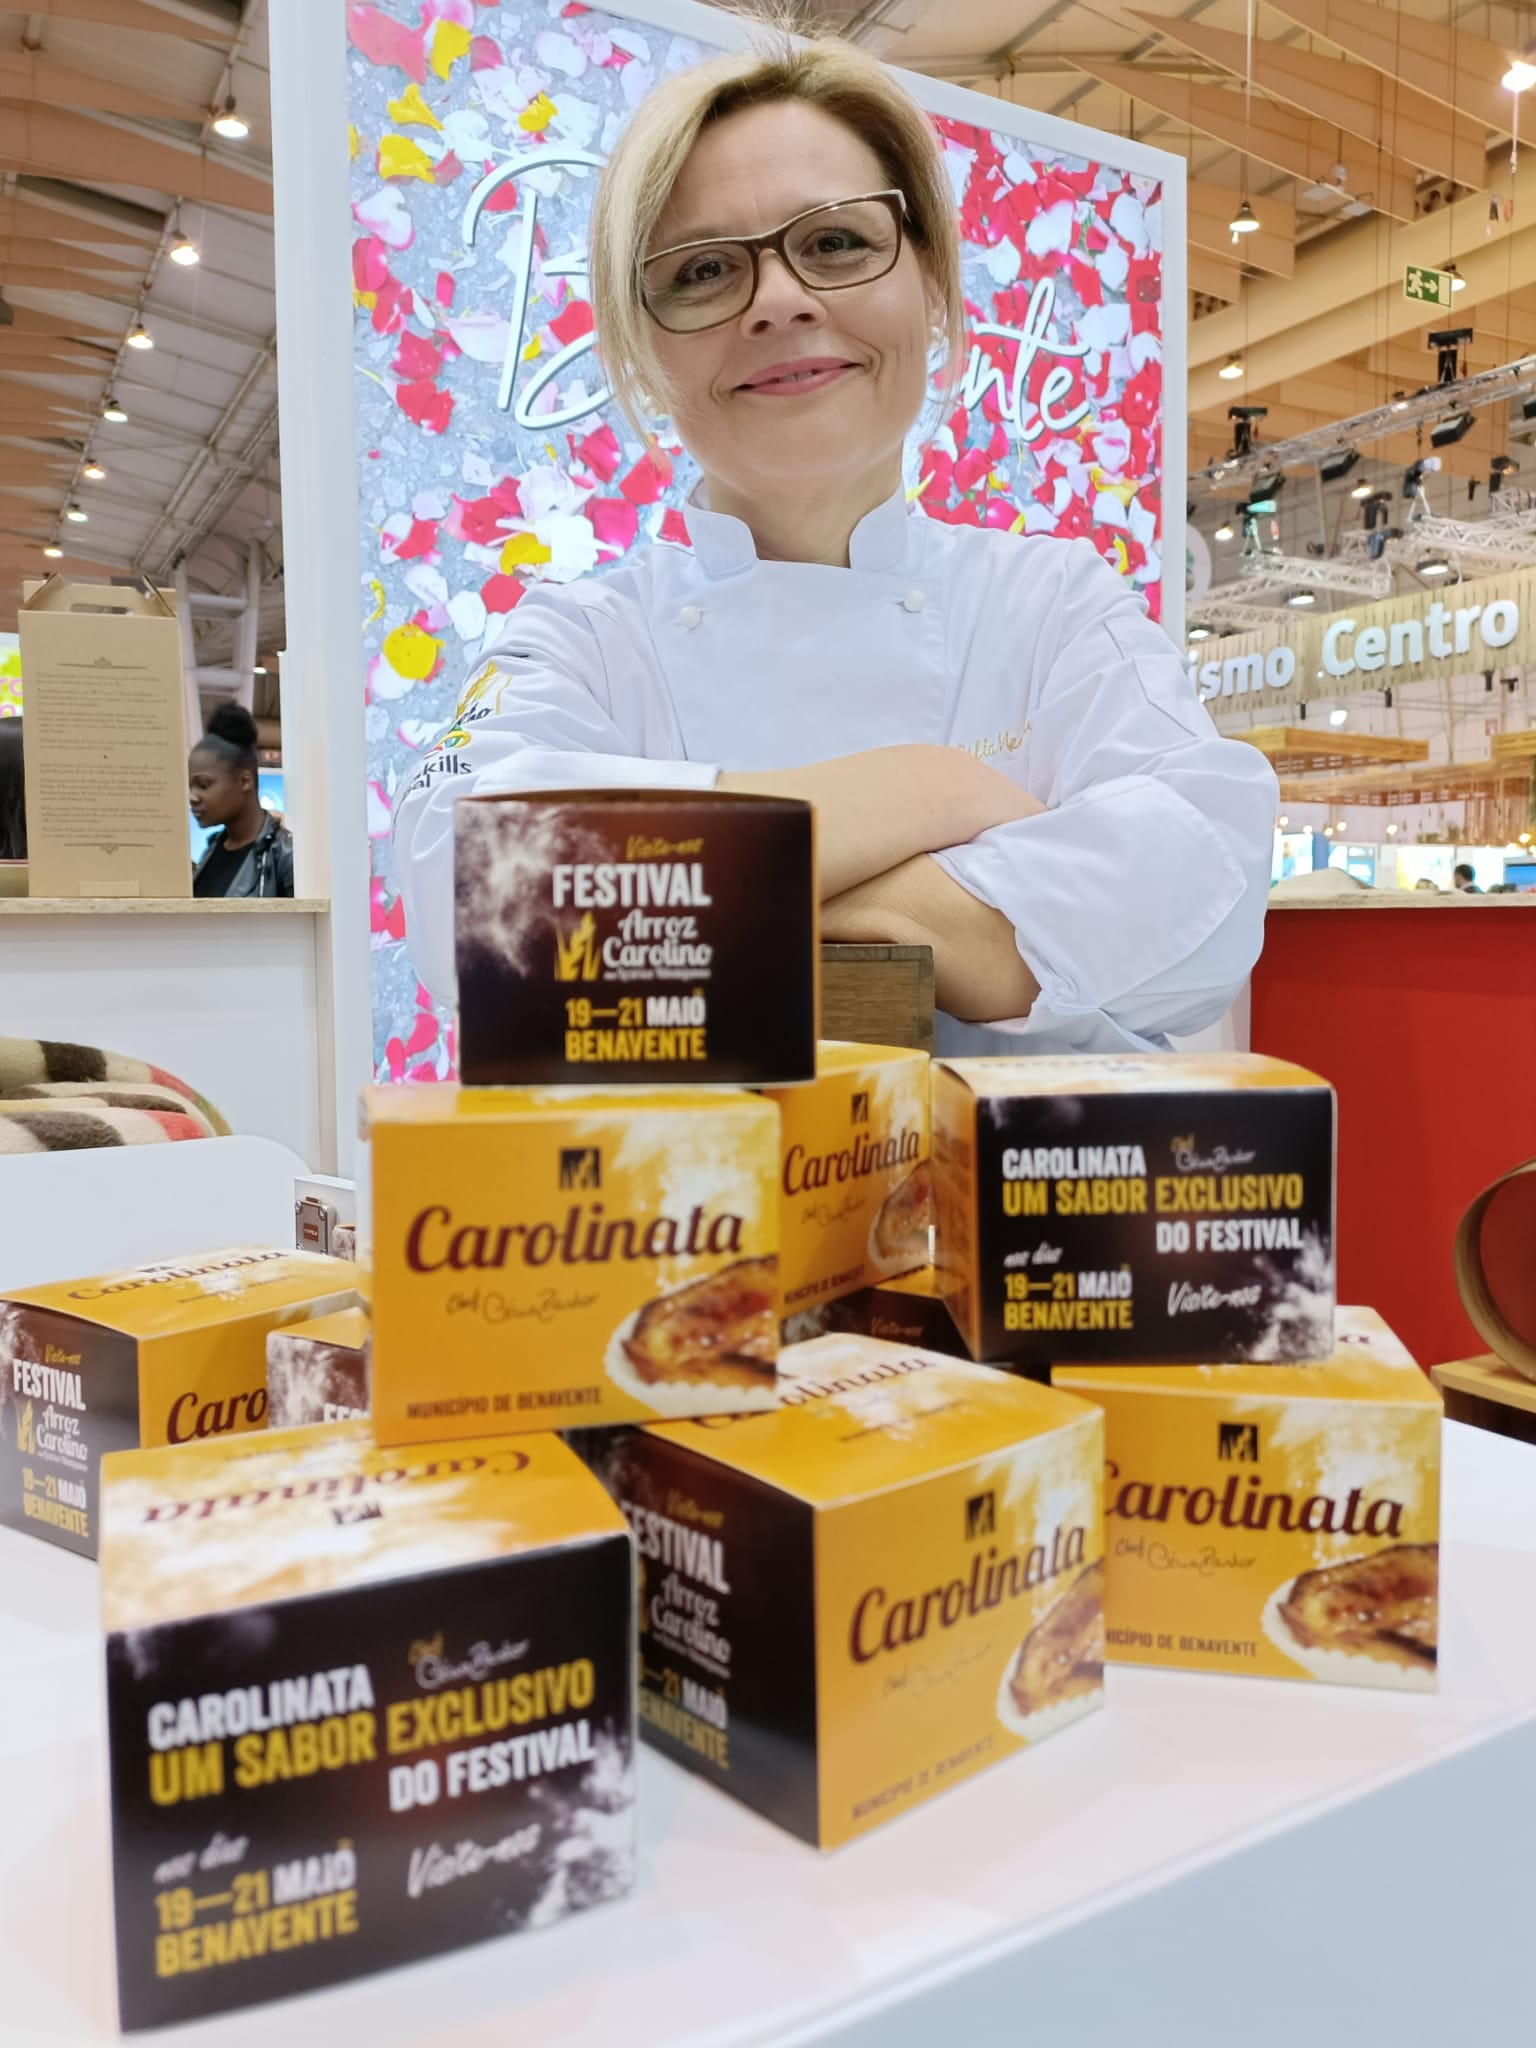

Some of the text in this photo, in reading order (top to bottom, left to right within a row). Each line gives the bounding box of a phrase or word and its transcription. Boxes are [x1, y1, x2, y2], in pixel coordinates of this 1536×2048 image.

[1321, 599, 1520, 677] Centro
[553, 863, 712, 907] FESTIVAL
[618, 909, 698, 941] Arroz
[602, 937, 712, 968] Carolino
[646, 997, 706, 1026] MAIO
[565, 1028, 706, 1062] BENAVENTE
[783, 1127, 919, 1196] Carolinata
[1002, 1145, 1146, 1179] CAROLINATA
[1003, 1174, 1303, 1216] UM SABOR EXCLUSIVO
[405, 1204, 743, 1274] Carolinata
[1156, 1218, 1304, 1253] DO FESTIVAL
[1078, 1270, 1132, 1299] MAIO
[1004, 1301, 1133, 1331] BENAVENTE
[13, 1358, 86, 1411] FESTIVAL
[517, 1387, 601, 1409] BENAVENTE
[42, 1404, 80, 1436] Arroz
[36, 1423, 88, 1461] Carolino
[848, 1526, 1086, 1666] Carolinata
[1158, 1633, 1173, 1651] DE
[1179, 1637, 1258, 1657] BENAVENTE
[148, 1664, 375, 1750] CAROLINATA
[149, 1742, 224, 1807] UM
[235, 1711, 376, 1789] SABOR
[387, 1658, 595, 1755] EXCLUSIVO
[389, 1719, 598, 1811] DO FESTIVAL
[273, 1849, 357, 1904] MAIO
[155, 1889, 359, 1978] BENAVENTE
